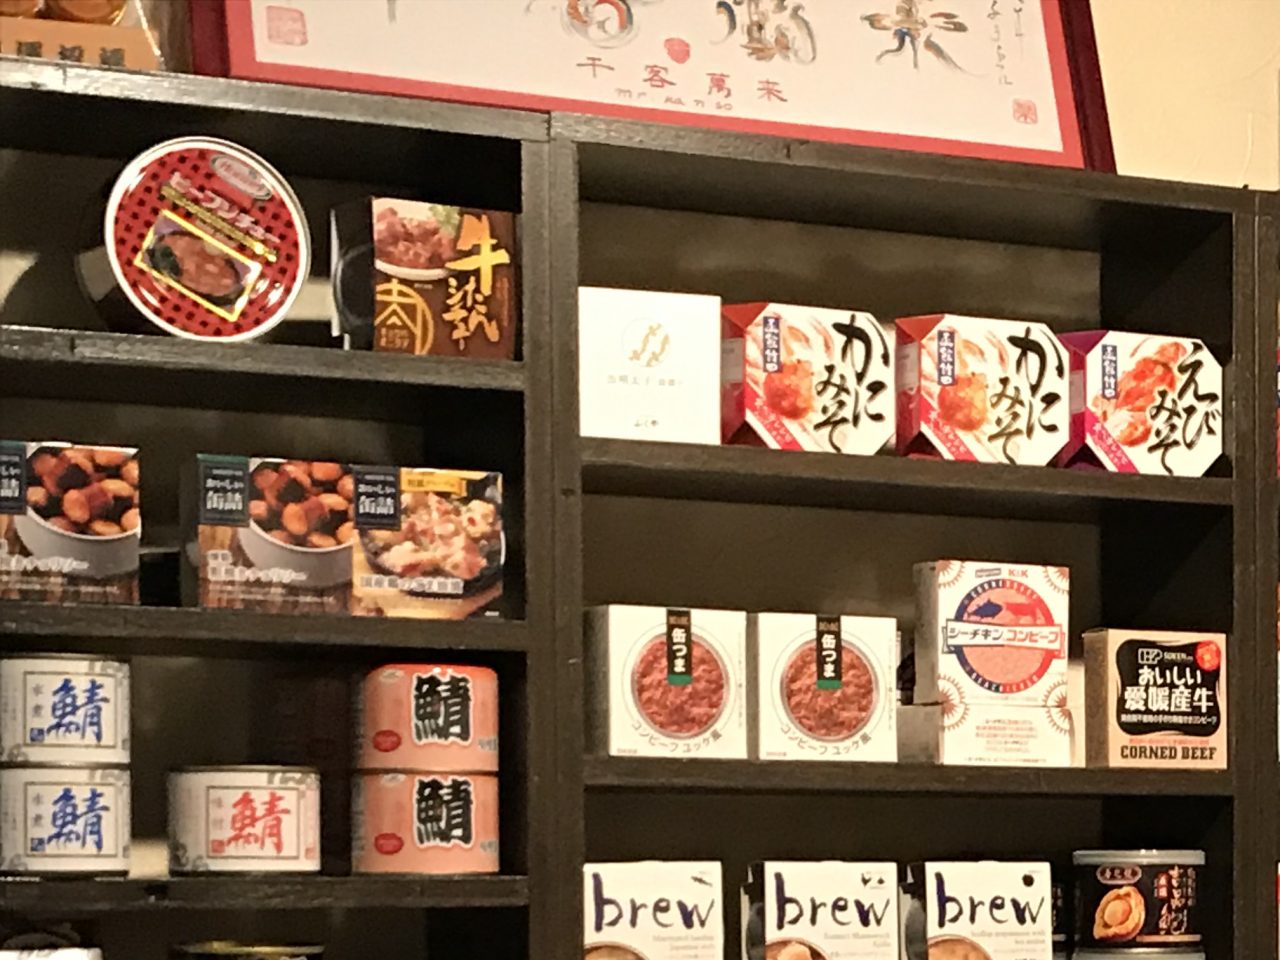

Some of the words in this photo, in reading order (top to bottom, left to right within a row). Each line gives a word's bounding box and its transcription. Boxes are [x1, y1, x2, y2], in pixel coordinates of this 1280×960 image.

[671, 627, 687, 674] 缶つま
[821, 633, 837, 678] 缶つま
[948, 626, 1004, 641] シーチキン
[1124, 686, 1214, 713] 愛媛産牛
[1137, 666, 1202, 685] おいしい
[47, 677, 111, 742] 鯖
[414, 674, 473, 743] 鯖
[1120, 745, 1178, 761] CORNED
[1181, 745, 1218, 761] BEEF
[47, 787, 111, 852] 鯖
[225, 790, 291, 854] 鯖
[415, 778, 474, 847] 鯖
[592, 871, 715, 933] brew
[774, 871, 890, 931] brew
[935, 871, 1045, 929] brew
